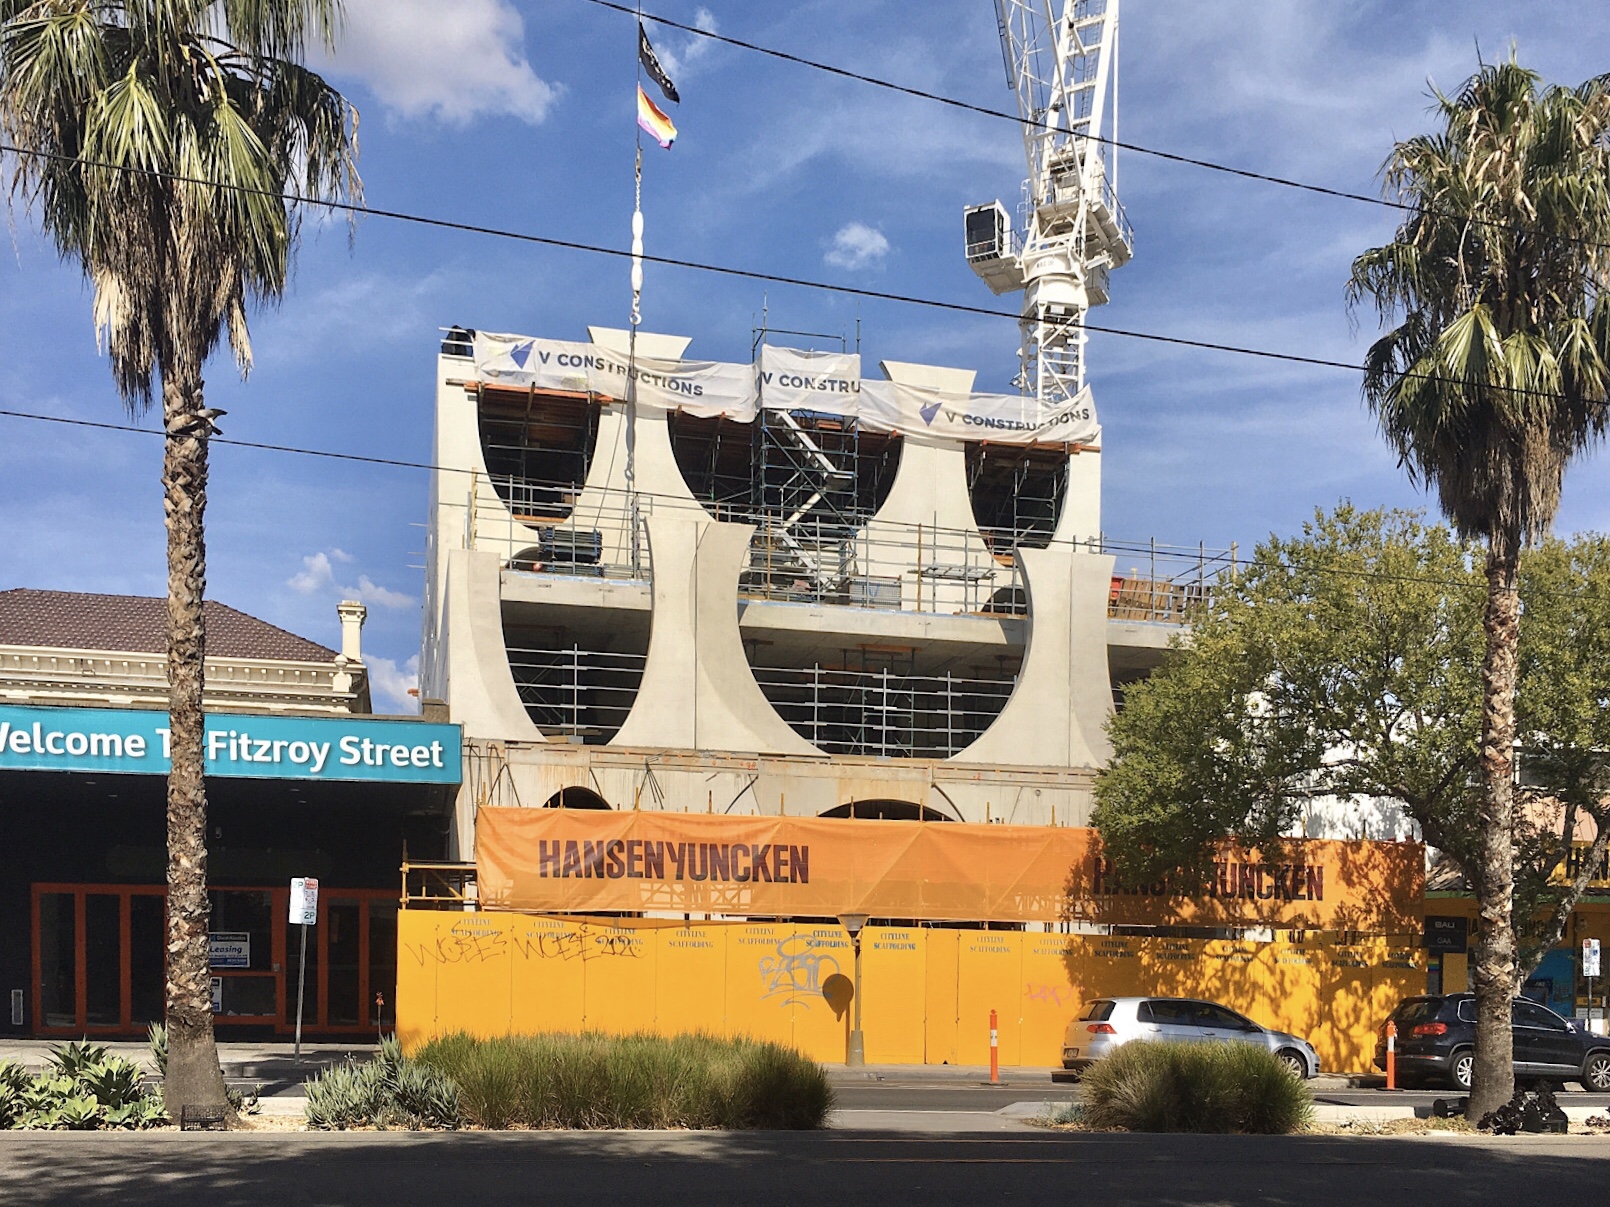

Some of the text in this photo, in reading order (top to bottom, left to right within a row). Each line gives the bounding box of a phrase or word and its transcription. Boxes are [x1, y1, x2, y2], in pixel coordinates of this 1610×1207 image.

[538, 351, 704, 396] V CONSTRUCTIONS
[760, 371, 773, 385] V
[945, 412, 957, 423] V
[0, 721, 146, 758] elcome
[208, 730, 330, 773] Fitzroy
[339, 736, 443, 768] Street
[304, 911, 315, 919] 2P
[675, 930, 707, 938] CITYLINE
[812, 930, 843, 938] CITYLINE
[880, 932, 910, 940] CITYLINE
[668, 940, 714, 948] SCAFFOLDING
[805, 939, 849, 948] SCAFFOLDING
[976, 936, 1005, 944] CITYLINE
[209, 946, 242, 954] Leasing
[873, 942, 917, 951] SCAFFOLDING
[969, 945, 1012, 954] SCAFFOLDING
